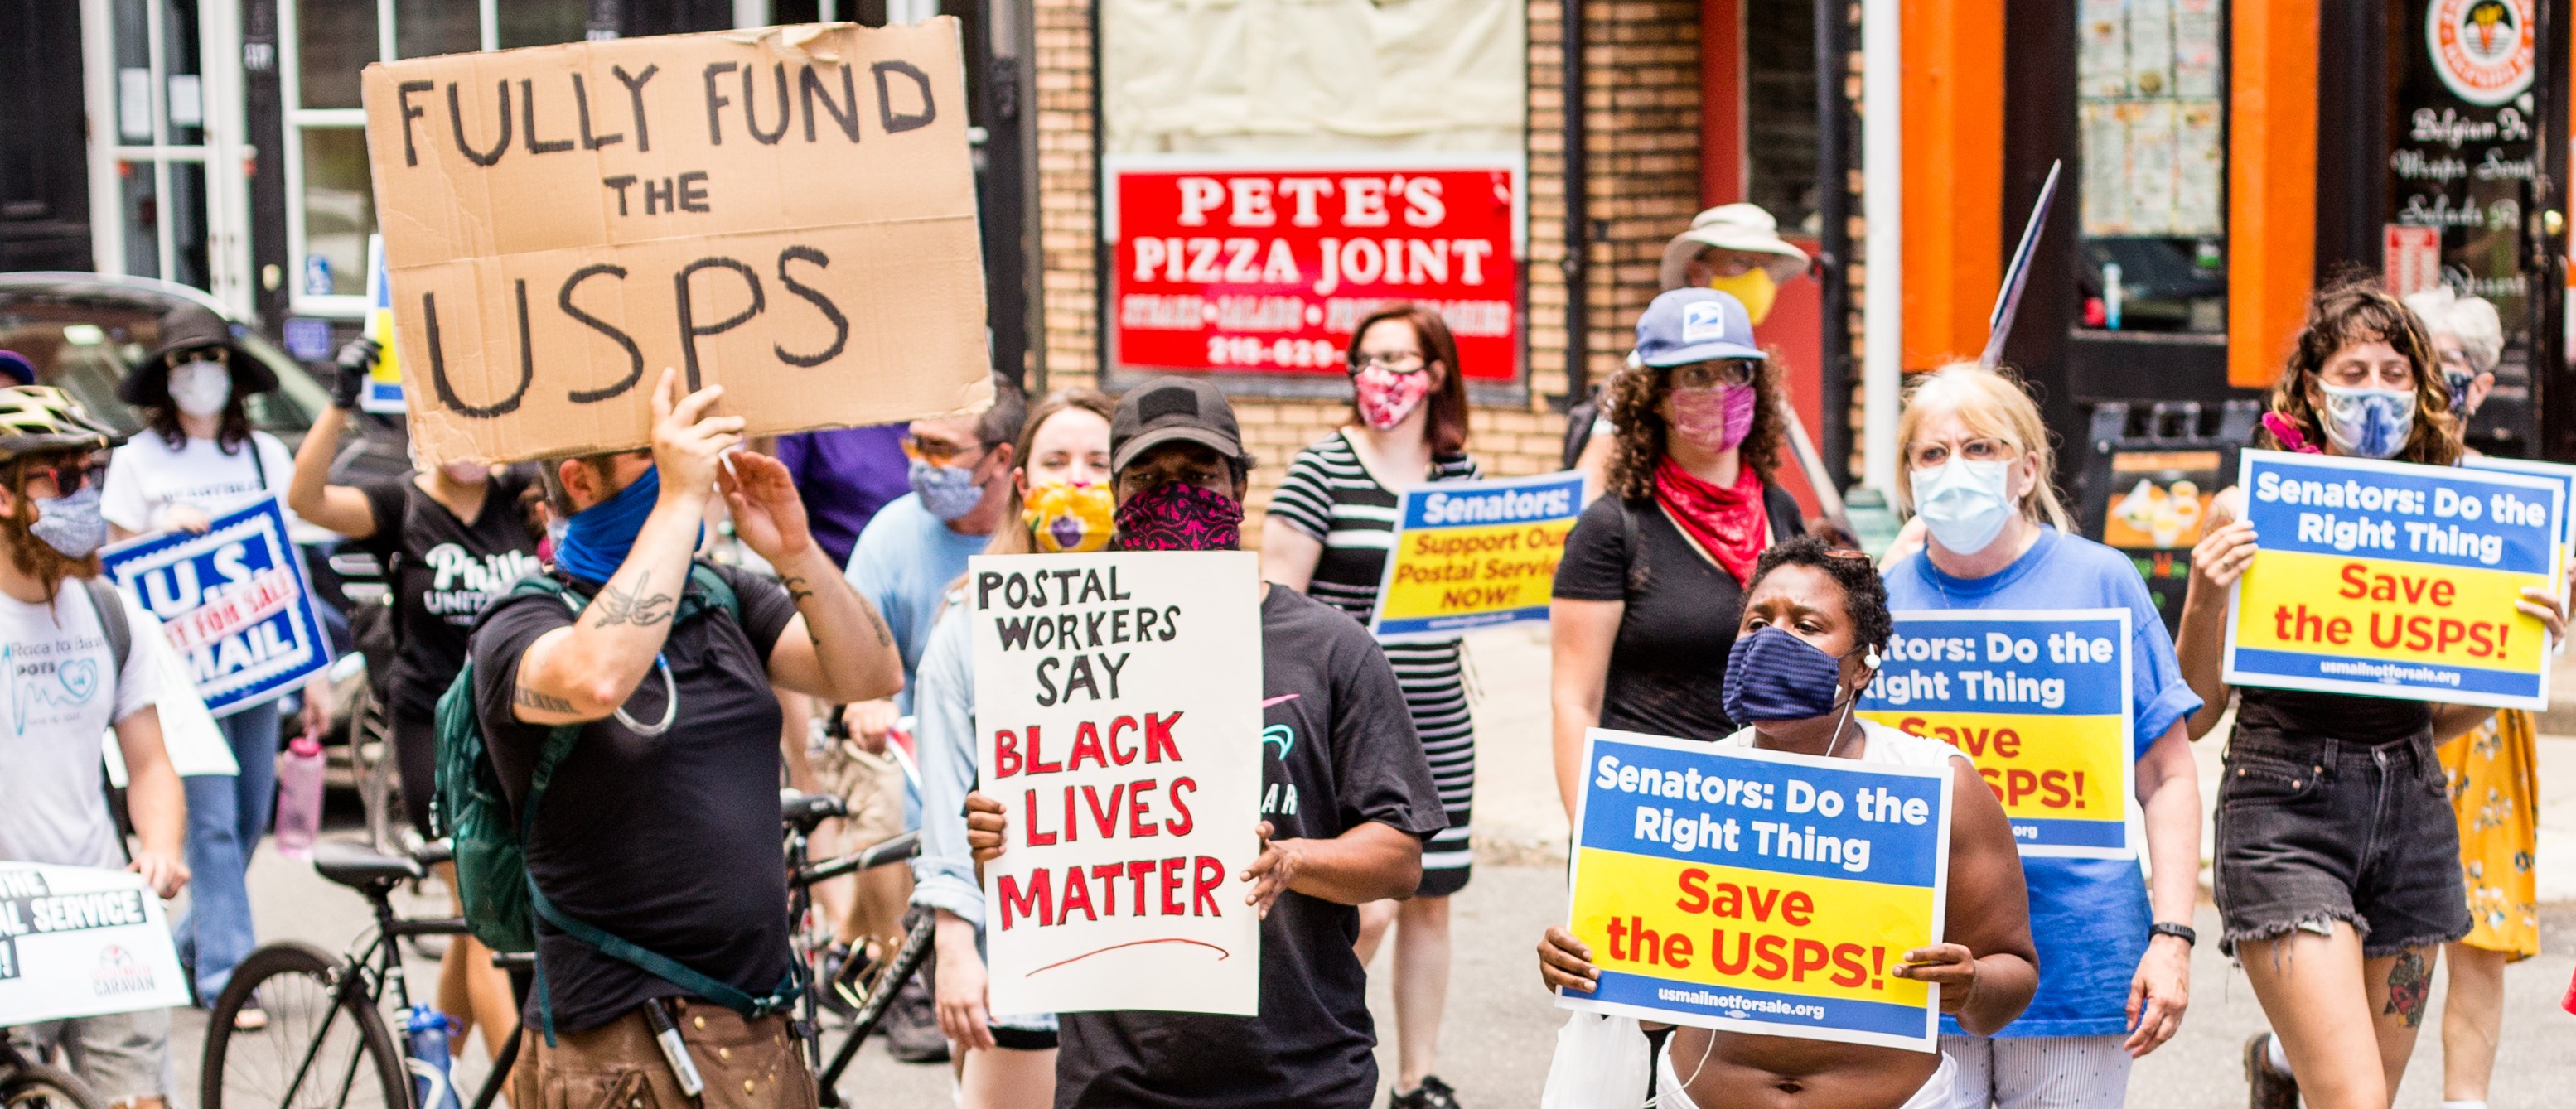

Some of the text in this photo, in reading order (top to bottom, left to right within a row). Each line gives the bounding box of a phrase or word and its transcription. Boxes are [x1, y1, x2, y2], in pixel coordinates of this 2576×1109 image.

[398, 60, 936, 167] FULLY FUND
[602, 171, 710, 216] THE
[1177, 174, 1446, 228] PETE'S
[1133, 237, 1492, 295] PIZZA JOINT
[424, 246, 849, 417] USPS
[1423, 489, 1570, 524] Senators:
[2256, 472, 2546, 528] Senators: Do the
[1414, 530, 1520, 557] Support
[2298, 513, 2503, 564] Right Thing
[144, 542, 270, 619] U.S.
[978, 566, 1130, 610] POSTAL
[1396, 559, 1477, 584] Postal
[1442, 585, 1520, 609] NOW!
[2338, 563, 2456, 607] Save
[996, 605, 1181, 652] WORKERS
[1881, 631, 2114, 663] tors: Do the
[2275, 605, 2509, 659] the USPS!
[1036, 653, 1130, 706] SAY
[1958, 670, 2065, 709] Thing
[2320, 660, 2460, 686] usmailnotforsale.org
[995, 711, 1184, 779] BLACK
[1025, 776, 1197, 847] LIVES
[1595, 755, 1929, 826] Senators: Do the
[1979, 767, 2085, 809] SPS!
[1634, 806, 1871, 872] Right Thing
[31, 890, 145, 933] SERVICE
[997, 856, 1225, 931] MATTER
[1676, 868, 1814, 926] Save
[1607, 916, 1885, 991] the USPS!
[93, 974, 157, 996] CARAVAN
[1658, 986, 1824, 1020] usmailnotforsale.org
